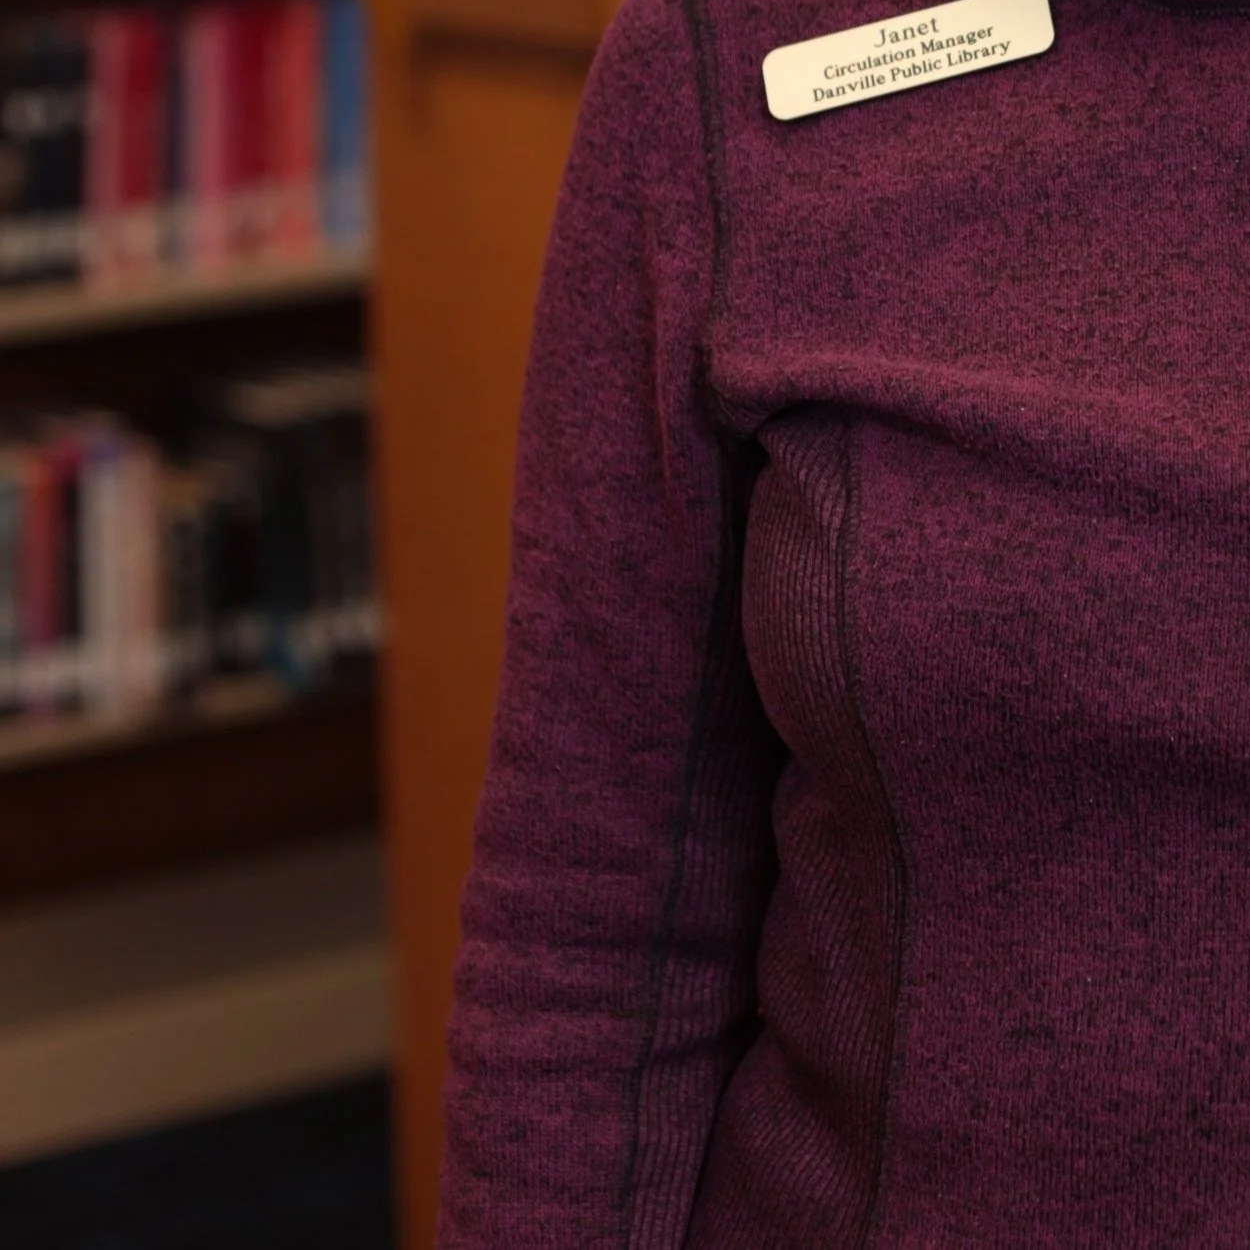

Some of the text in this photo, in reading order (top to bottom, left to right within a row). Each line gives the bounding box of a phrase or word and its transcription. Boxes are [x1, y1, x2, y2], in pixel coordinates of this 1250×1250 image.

[823, 26, 994, 80] Circulation Manager
[873, 17, 940, 48] Janet
[812, 40, 1012, 103] Danville Public Library
